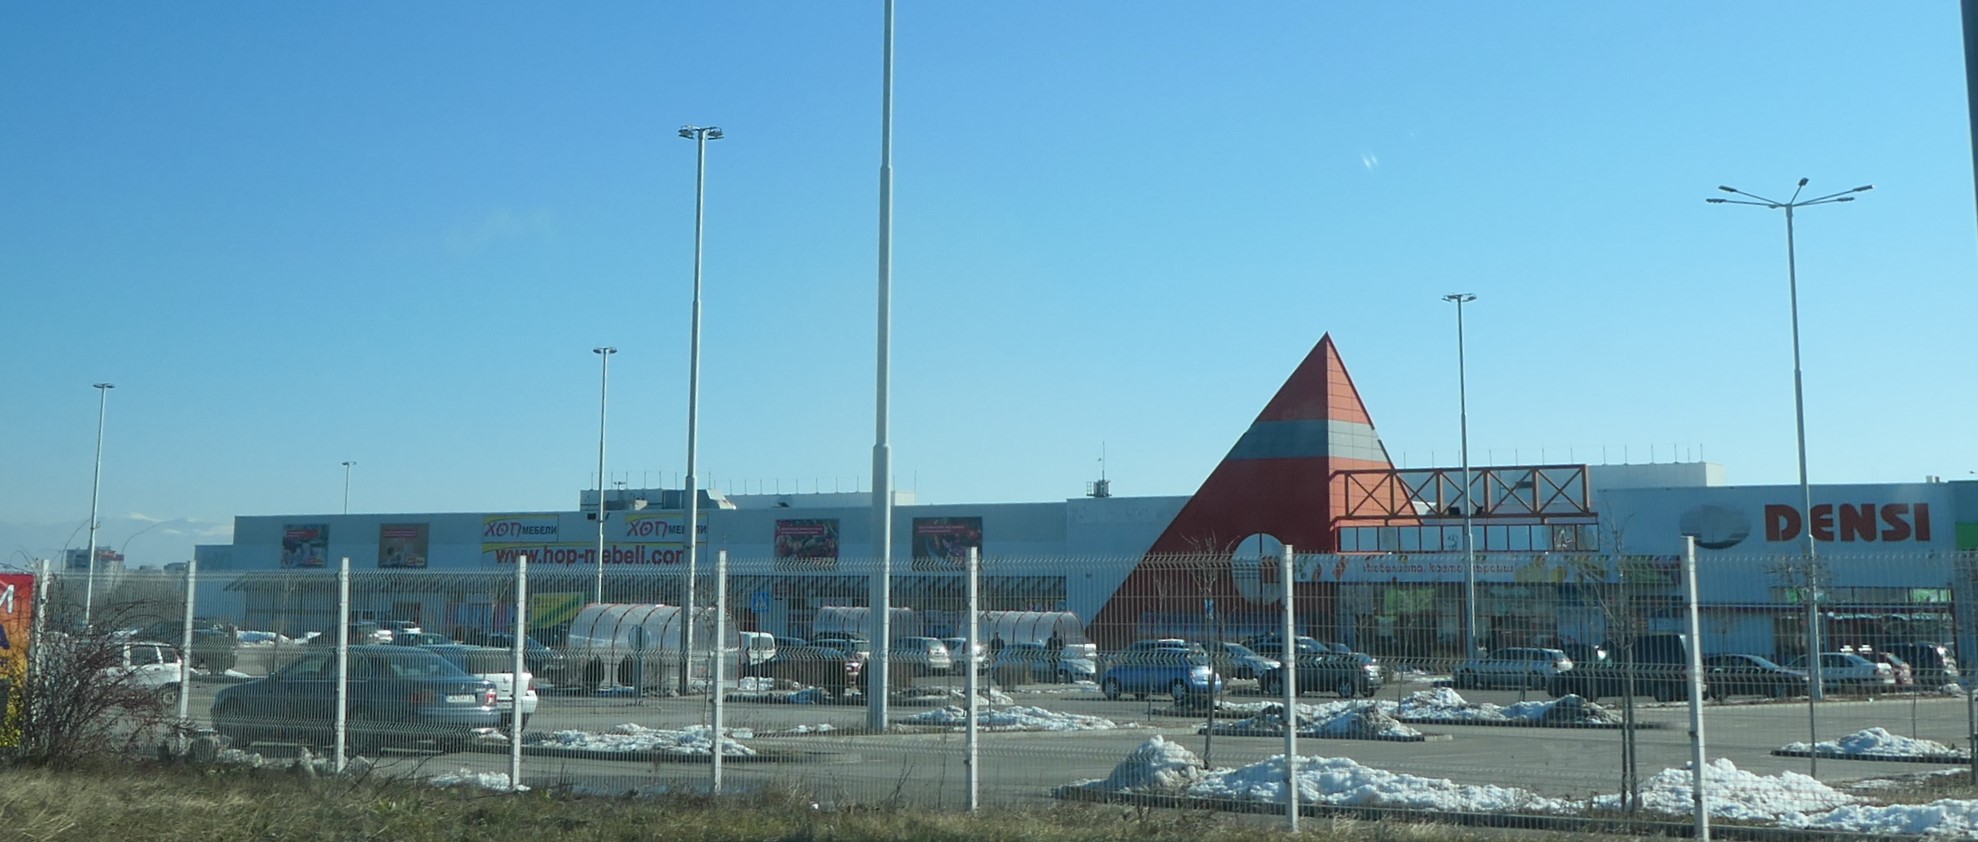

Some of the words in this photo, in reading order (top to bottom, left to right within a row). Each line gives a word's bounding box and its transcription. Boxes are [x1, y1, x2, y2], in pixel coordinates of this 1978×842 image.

[484, 520, 522, 538] ХОП
[626, 520, 667, 538] ХОП
[668, 525, 708, 536] МЕИ
[1765, 503, 1931, 542] DENSI
